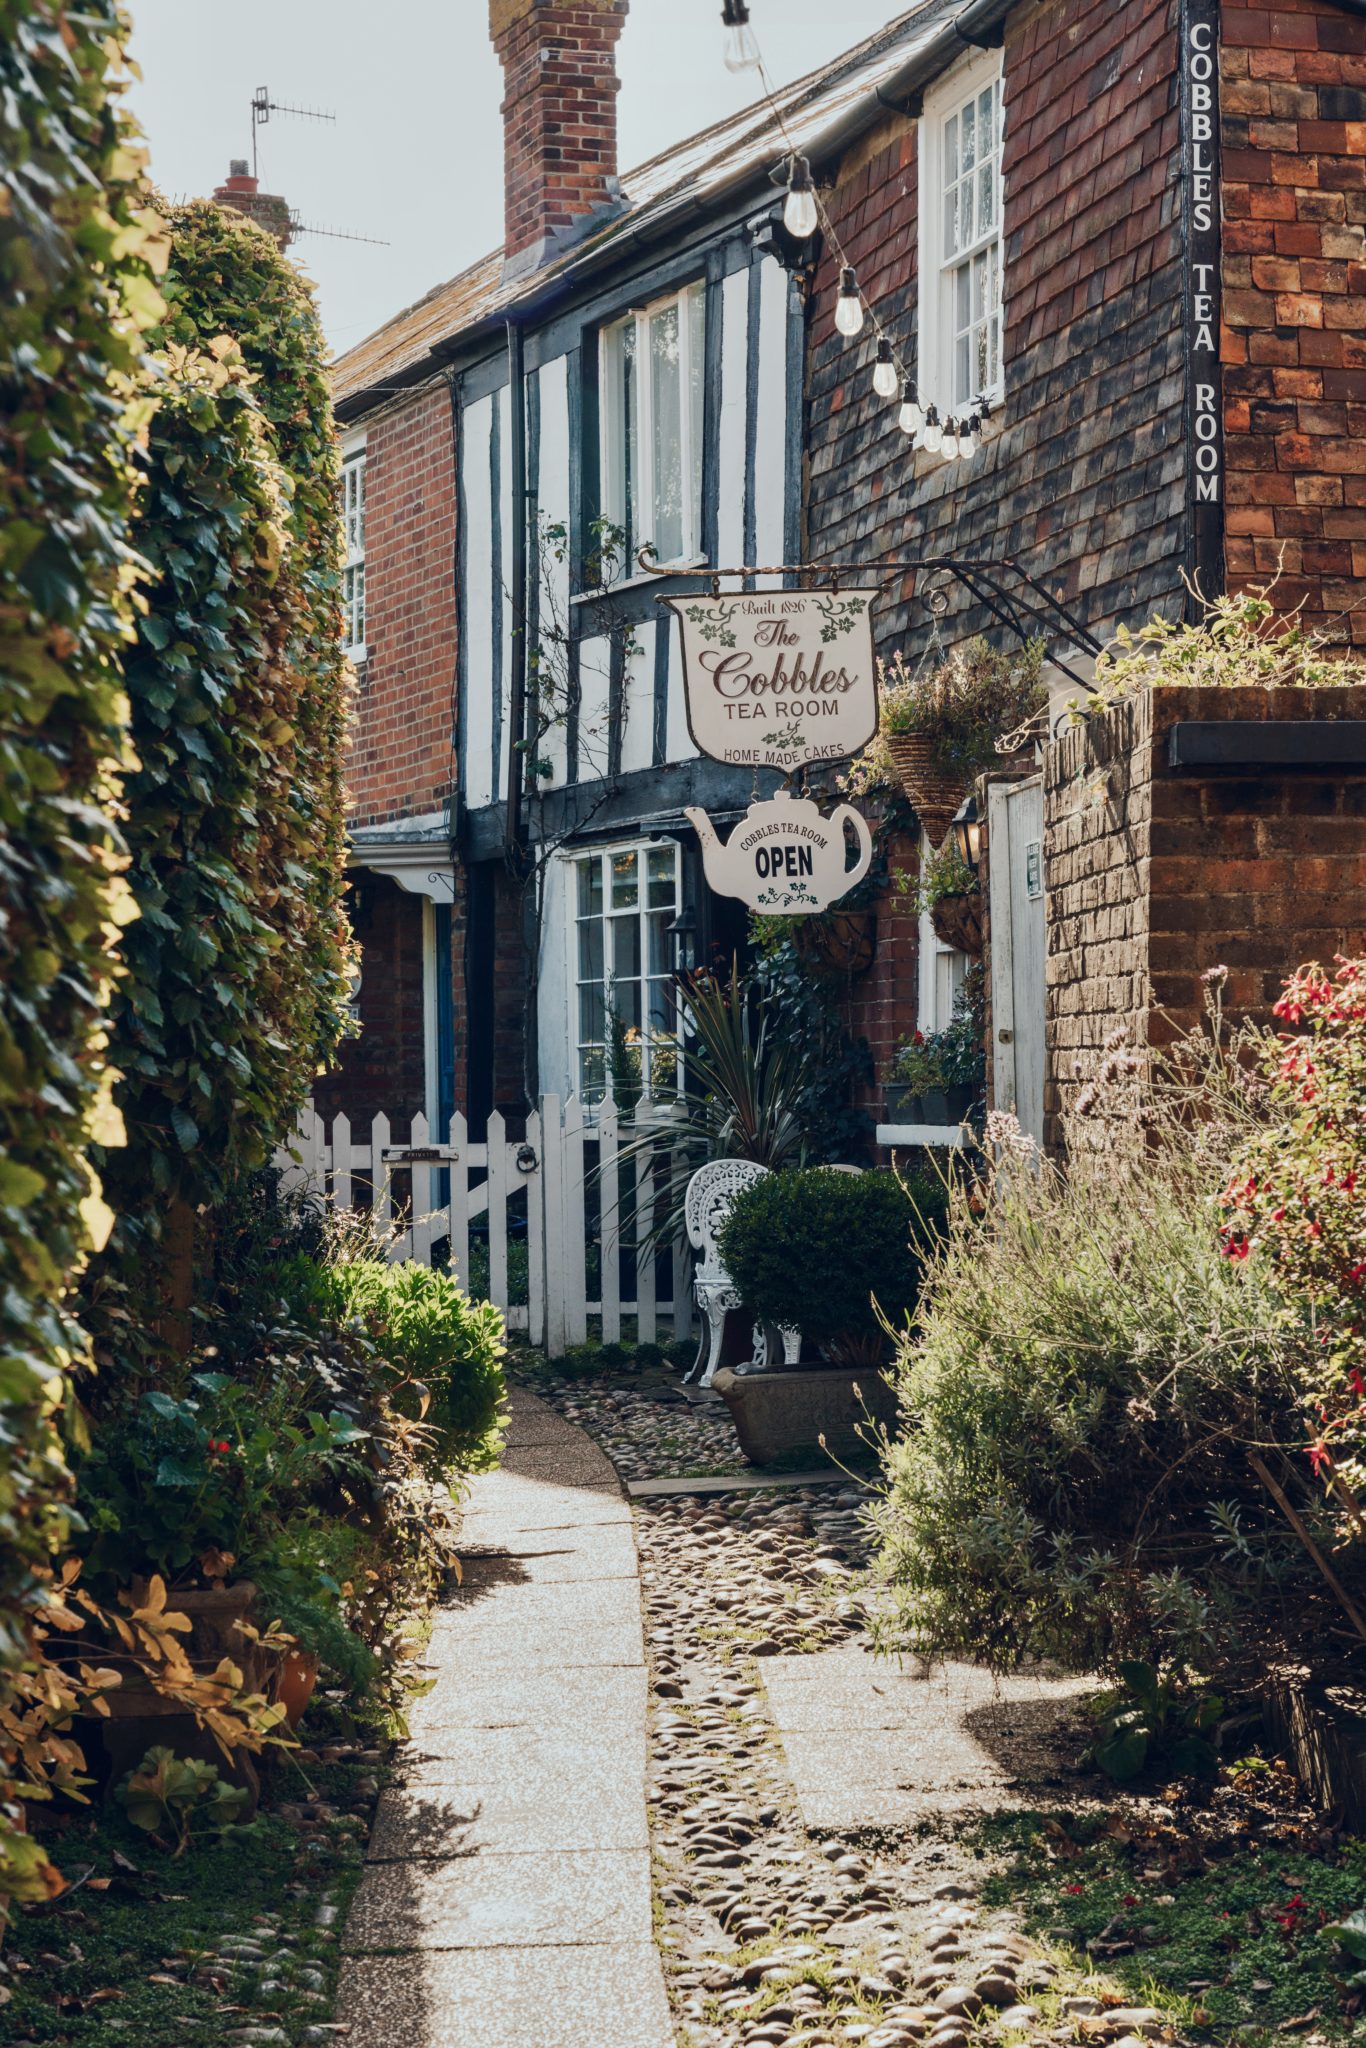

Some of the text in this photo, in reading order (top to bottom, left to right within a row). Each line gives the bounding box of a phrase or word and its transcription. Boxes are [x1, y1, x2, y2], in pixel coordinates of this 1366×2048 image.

[1190, 23, 1218, 502] COBBLES TEA ROOM
[741, 599, 775, 615] Built
[753, 618, 801, 647] The
[698, 650, 859, 699] Cobbles
[723, 699, 839, 720] TEA ROOM
[724, 743, 846, 765] HOME MADE CAKES
[740, 822, 828, 851] COBBLES TEA ROOM
[755, 845, 813, 879] OPEN
